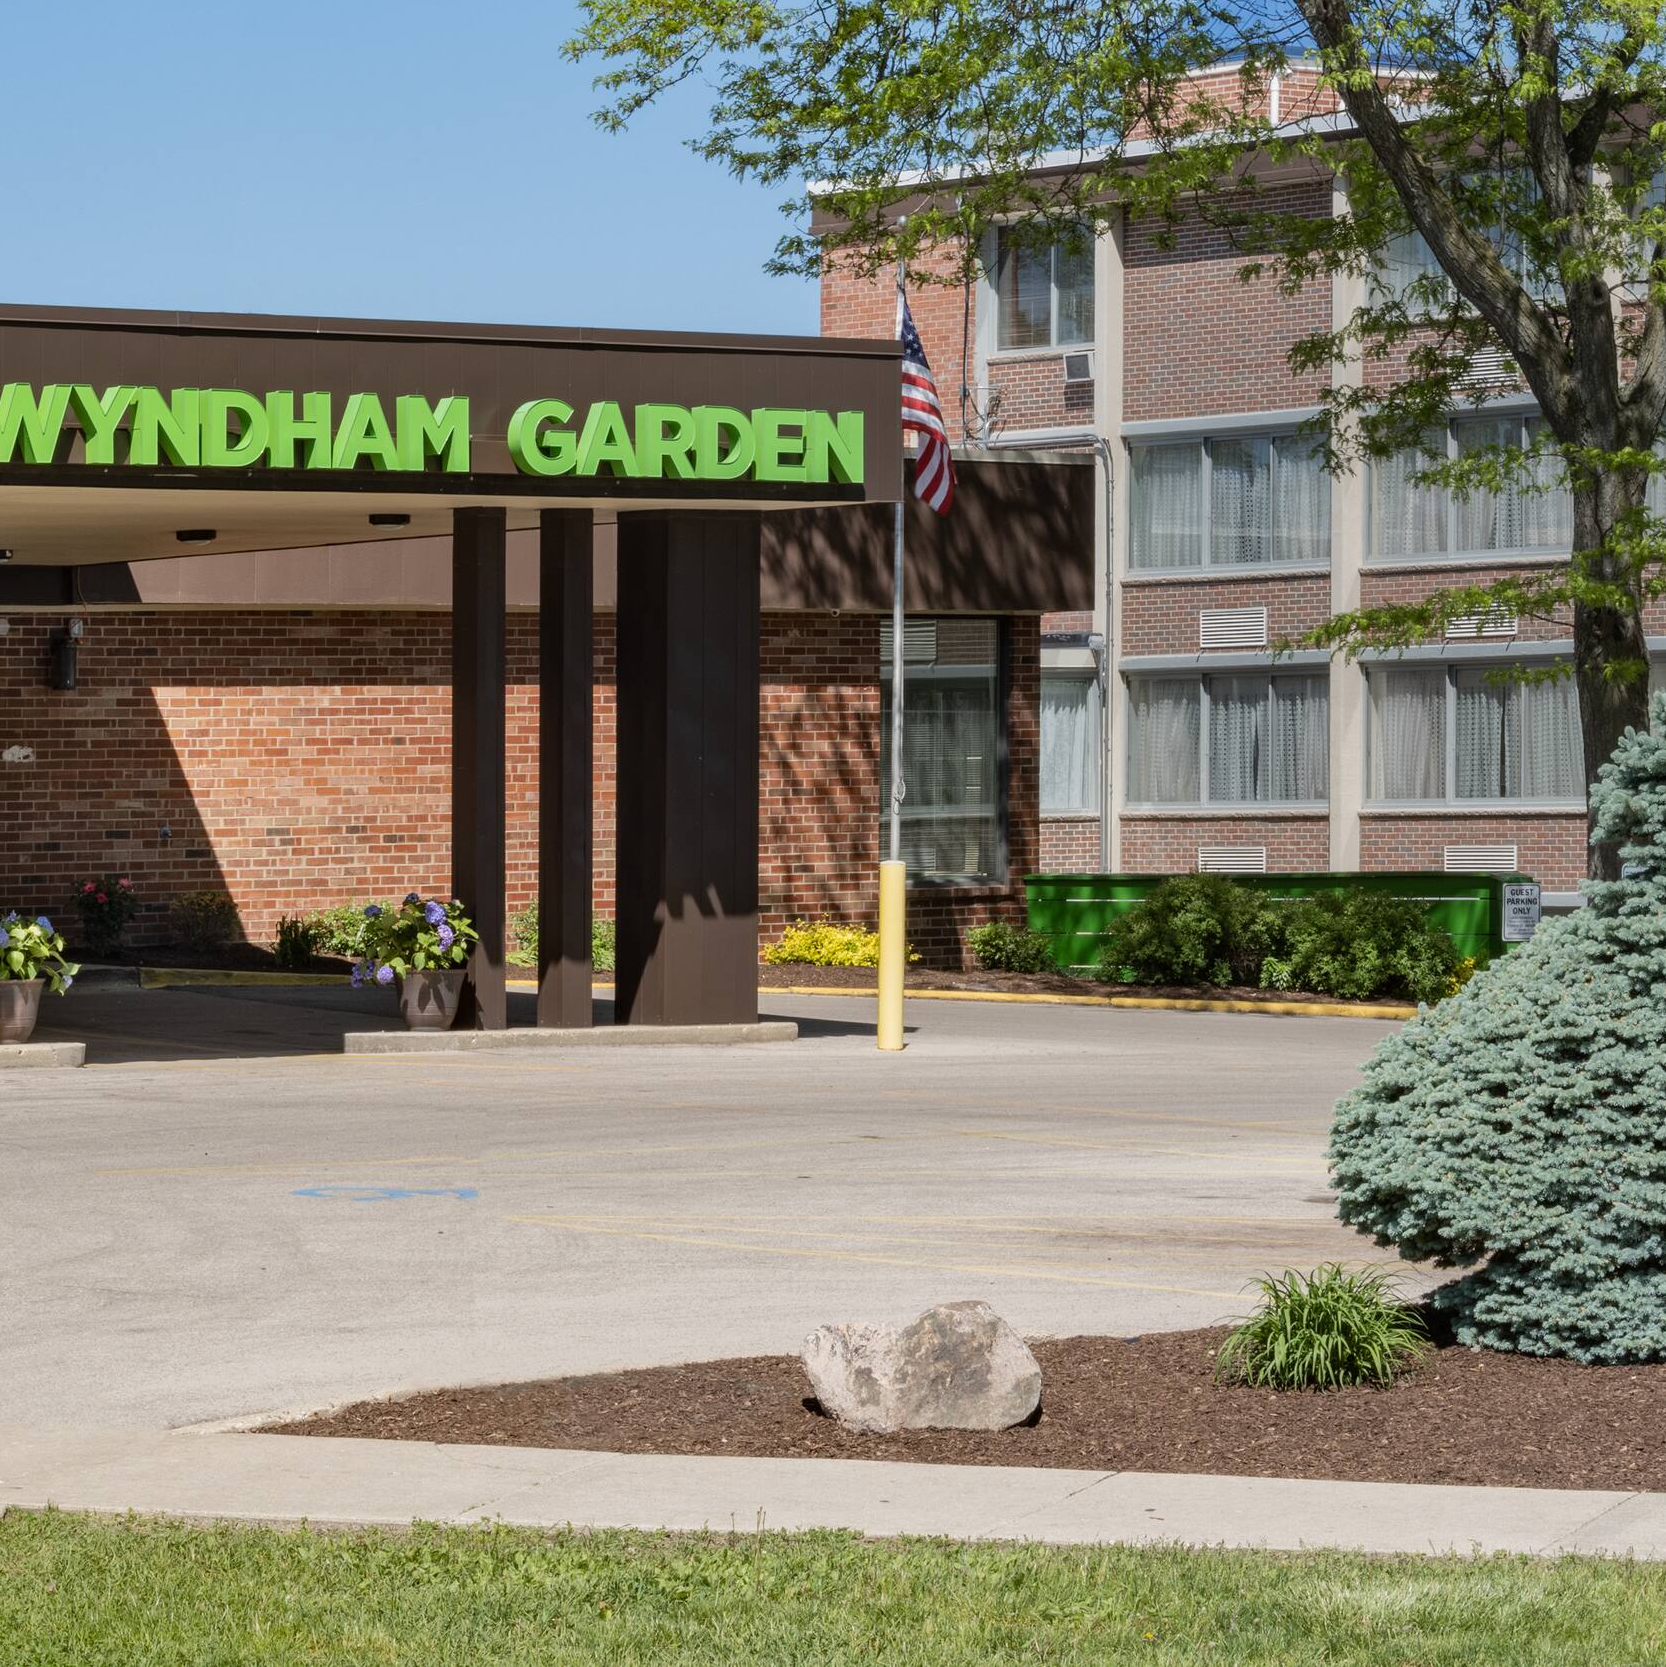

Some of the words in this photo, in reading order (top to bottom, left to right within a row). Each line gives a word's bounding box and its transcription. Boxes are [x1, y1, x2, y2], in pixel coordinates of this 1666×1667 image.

[507, 398, 865, 484] GARDEN
[1510, 888, 1534, 896] GUEST
[1507, 897, 1538, 905] PARKING
[1513, 907, 1531, 915] ONLY
